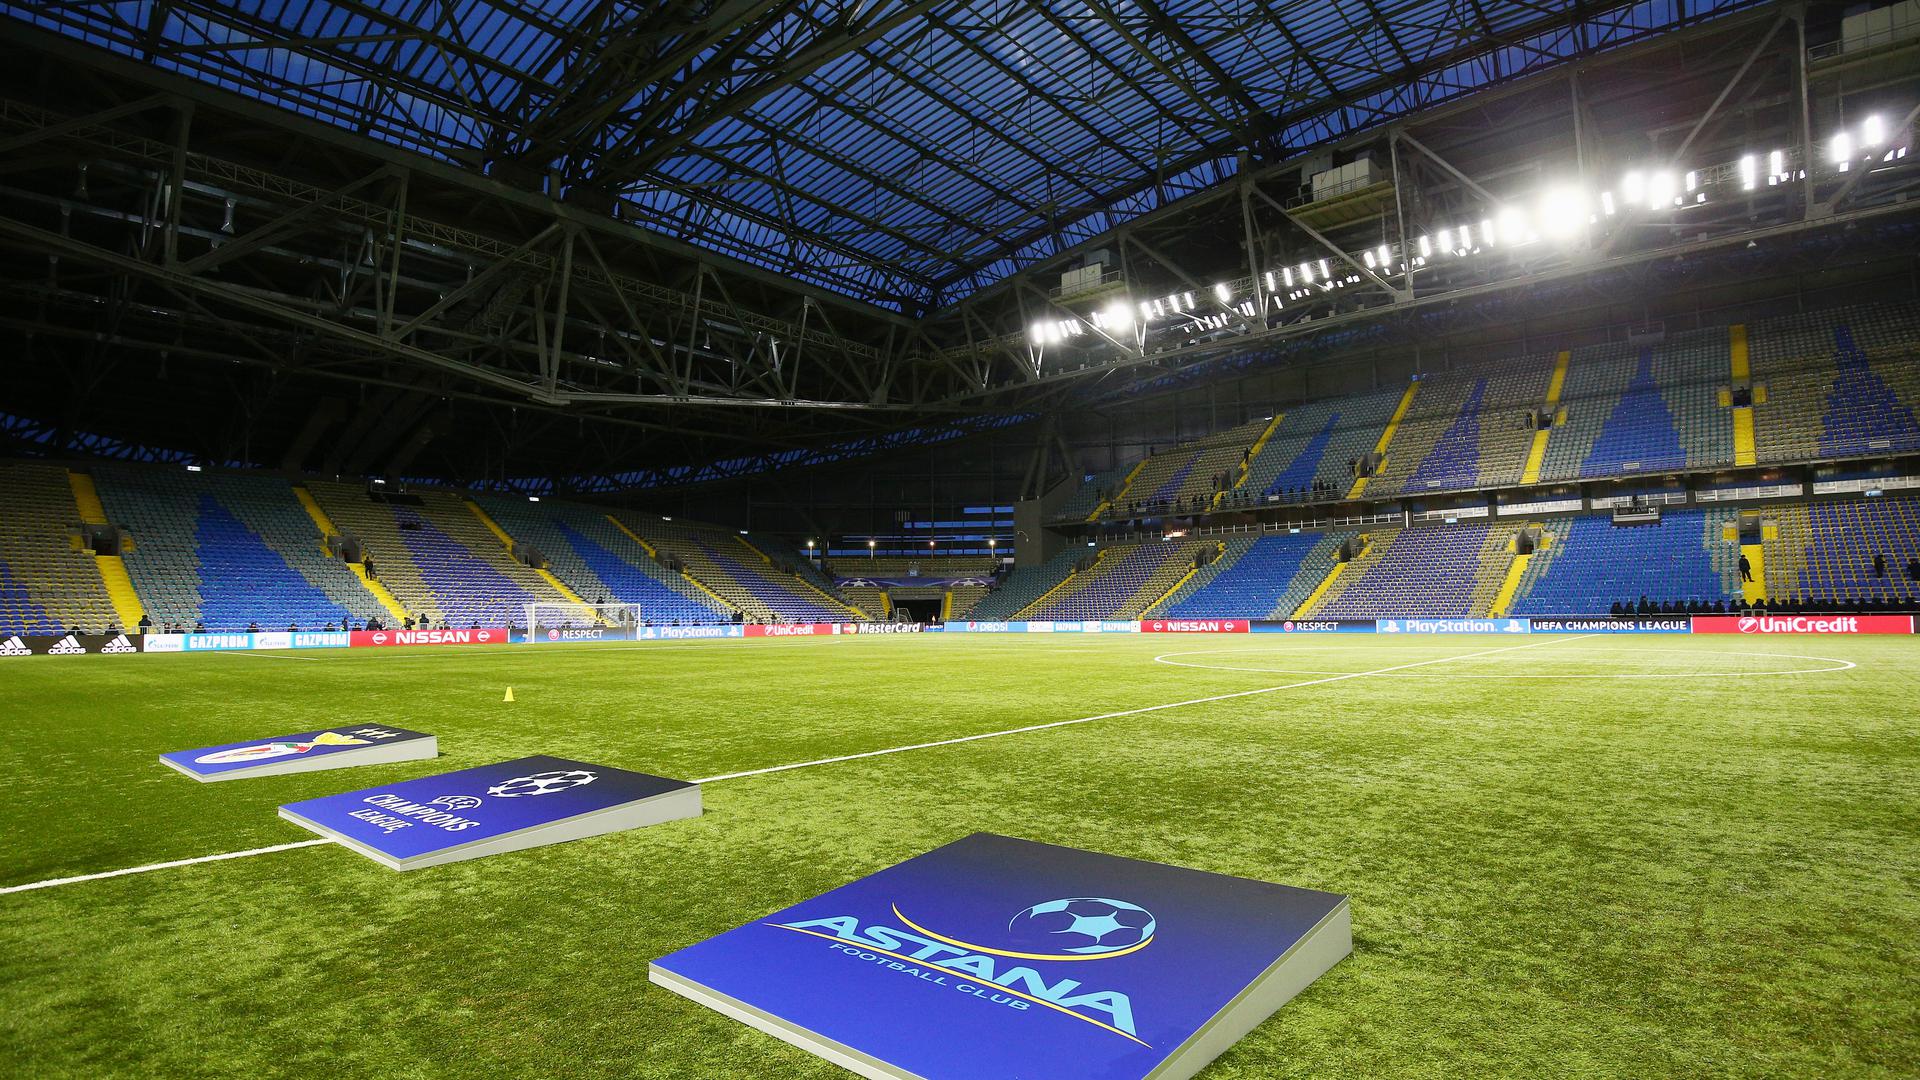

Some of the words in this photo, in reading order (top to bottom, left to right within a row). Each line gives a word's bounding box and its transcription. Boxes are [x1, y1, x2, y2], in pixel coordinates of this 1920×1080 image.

[774, 625, 814, 635] UniCredit
[859, 622, 920, 634] MasterCard
[980, 621, 1008, 633] pepsi
[1167, 622, 1219, 632] NISSAN
[1297, 622, 1339, 632] RESPECT
[1406, 620, 1496, 634] PlayStation
[1534, 621, 1563, 632] UEFA
[1565, 621, 1635, 632] CHAMPIONS
[1639, 621, 1687, 631] LEAGUE
[1760, 617, 1858, 633] UniCredit
[395, 631, 470, 644] NISSAN
[562, 629, 604, 640] RESPECT
[661, 626, 722, 638] PlayStation
[189, 635, 248, 648] GAZPROM
[295, 634, 347, 646] GAZPROM
[363, 794, 480, 831] CHAMPIONS
[348, 808, 413, 834] LEAGUE
[789, 915, 1137, 1036] ASTANA
[829, 943, 947, 986] FOOTBALL
[956, 983, 1031, 1011] CLUB
